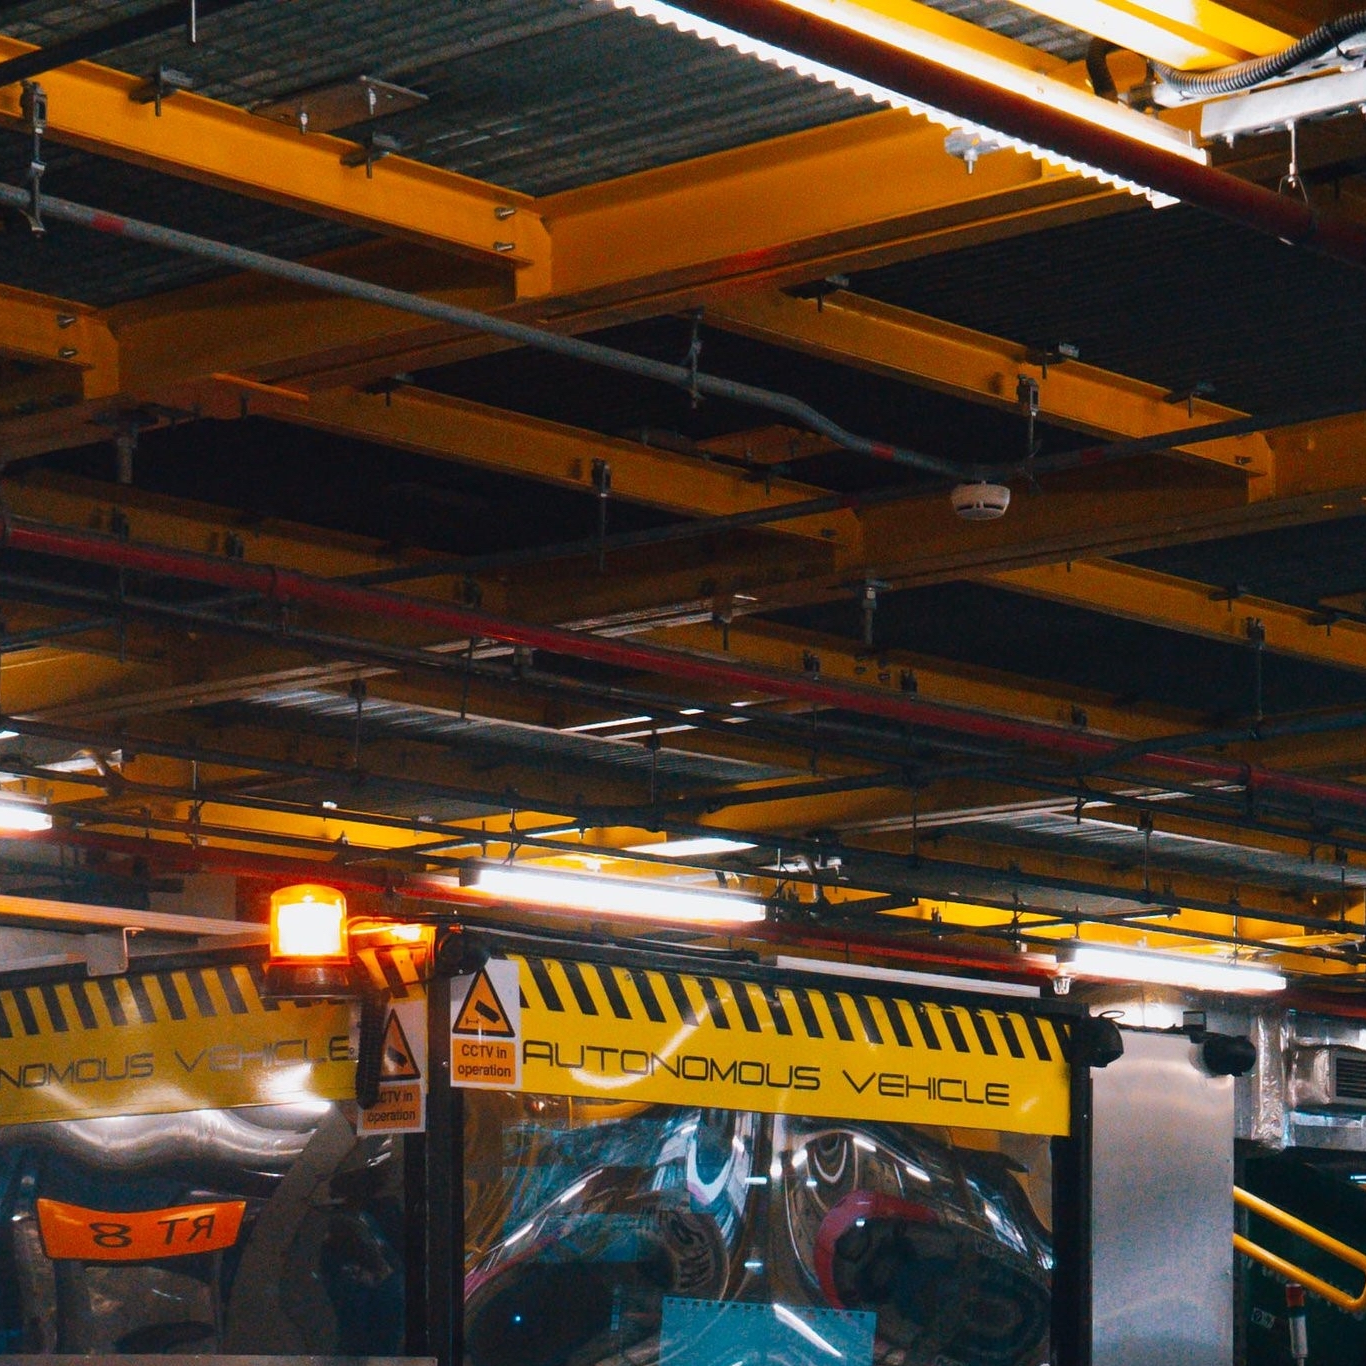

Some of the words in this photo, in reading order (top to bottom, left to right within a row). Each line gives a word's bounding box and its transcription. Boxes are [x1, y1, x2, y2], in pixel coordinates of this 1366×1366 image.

[174, 1035, 350, 1073] VEHICLE
[461, 1043, 494, 1059] CCTV
[497, 1046, 507, 1059] in
[457, 1064, 512, 1078] operation
[523, 1039, 821, 1091] AUTONOMOUS
[842, 1069, 1010, 1107] VEHICLE
[401, 1091, 413, 1101] in
[367, 1108, 416, 1124] operation
